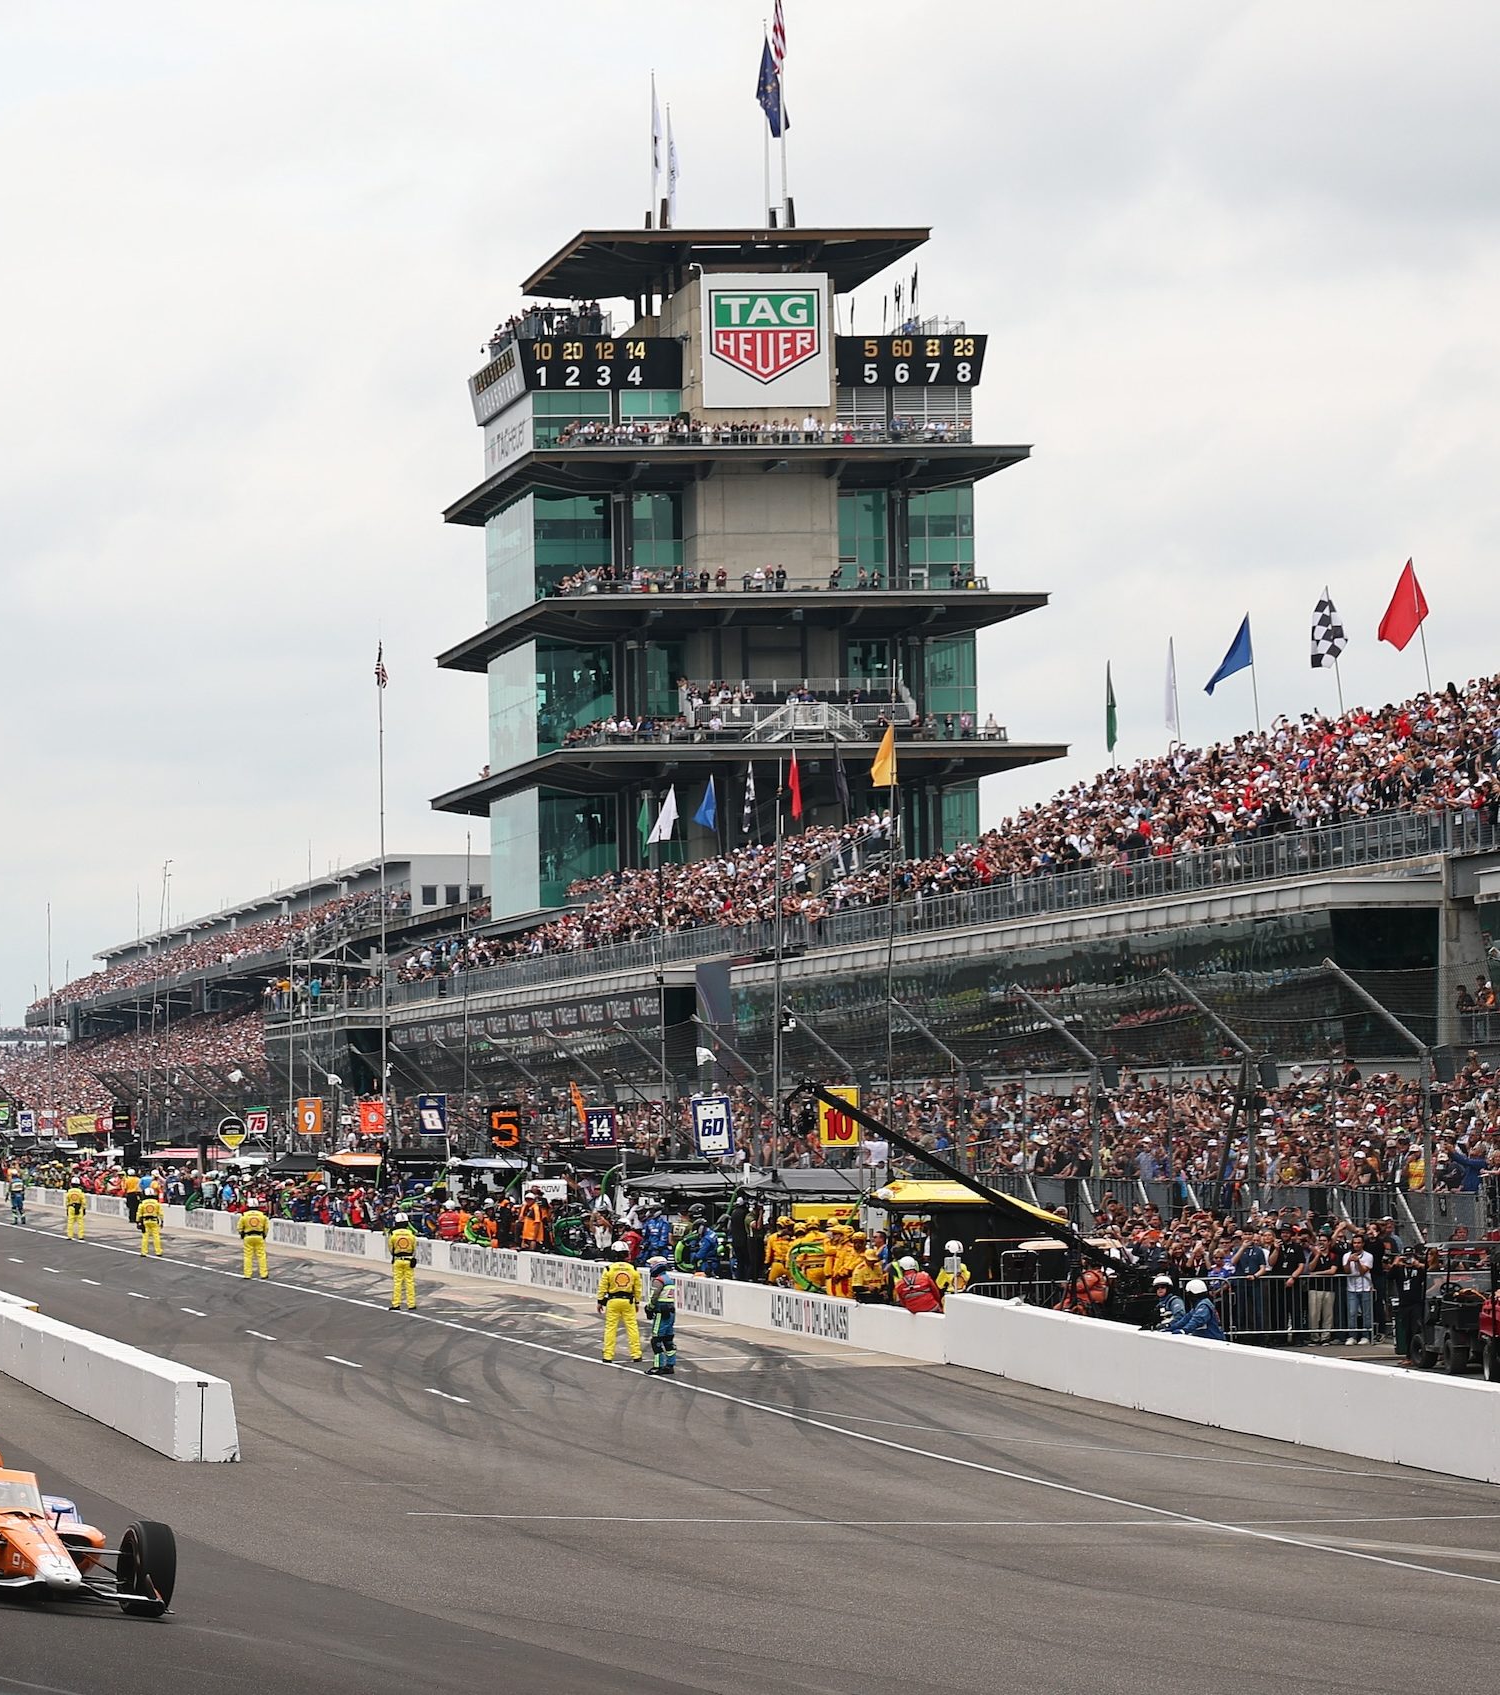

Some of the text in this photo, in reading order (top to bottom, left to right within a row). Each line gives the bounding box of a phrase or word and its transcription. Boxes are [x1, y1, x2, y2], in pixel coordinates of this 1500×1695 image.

[720, 297, 808, 325] TAG
[533, 342, 552, 360] 10
[562, 342, 583, 360] 20
[595, 341, 614, 360] 12
[718, 331, 811, 375] HEUER
[864, 339, 878, 358] 5
[892, 339, 912, 358] 60
[954, 338, 974, 357] 23
[536, 366, 547, 386] 1
[565, 366, 580, 386] 2
[596, 366, 611, 386] 3
[627, 366, 642, 386] 4
[864, 362, 972, 384] 5 6 7 8
[250, 1116, 266, 1132] 75
[304, 1111, 316, 1130] 9
[420, 1109, 444, 1130] 8
[491, 1110, 520, 1147] 5
[590, 1118, 611, 1138] 14
[701, 1118, 724, 1137] 60
[824, 1108, 853, 1140] 10
